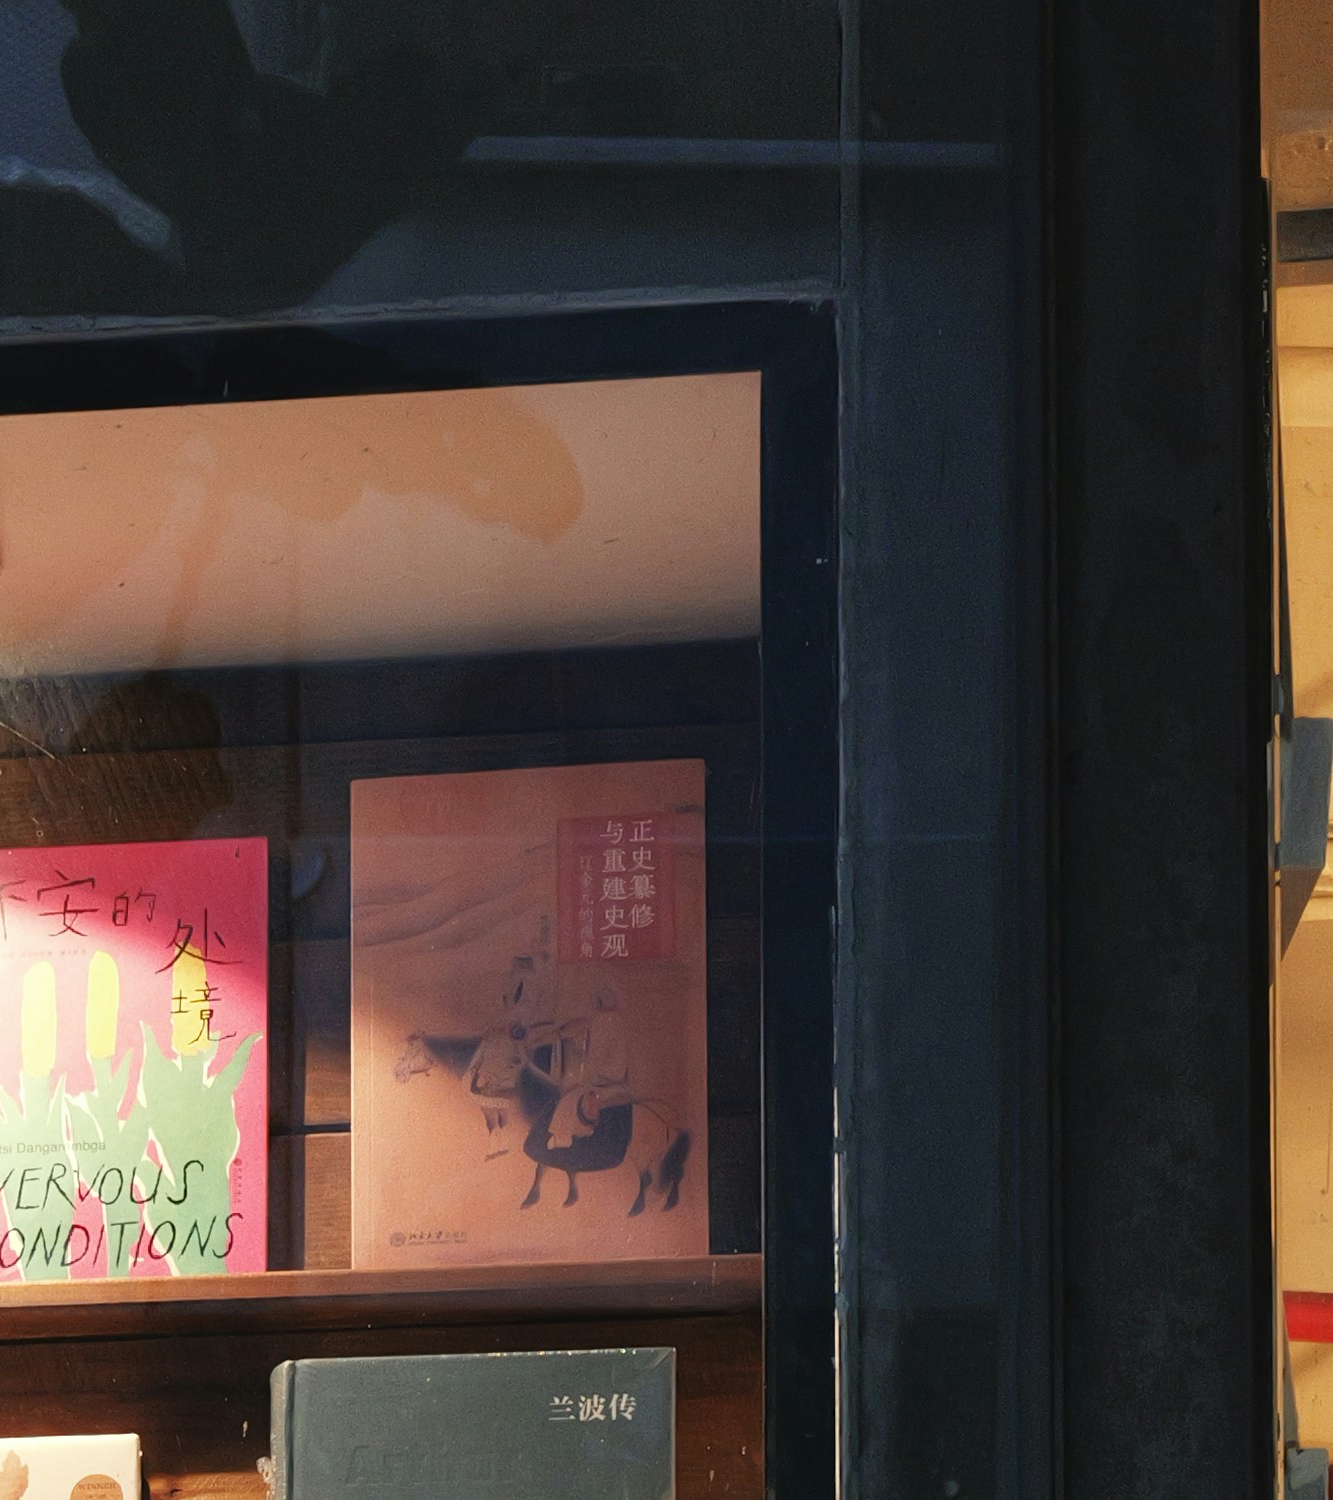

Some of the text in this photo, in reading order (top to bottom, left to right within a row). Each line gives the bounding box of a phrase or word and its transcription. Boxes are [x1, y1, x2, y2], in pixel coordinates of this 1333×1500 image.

[598, 819, 630, 959] 与重建史观
[628, 818, 658, 930] 正史纂修
[155, 906, 245, 1047] 处境
[547, 1393, 637, 1423] 兰波传
